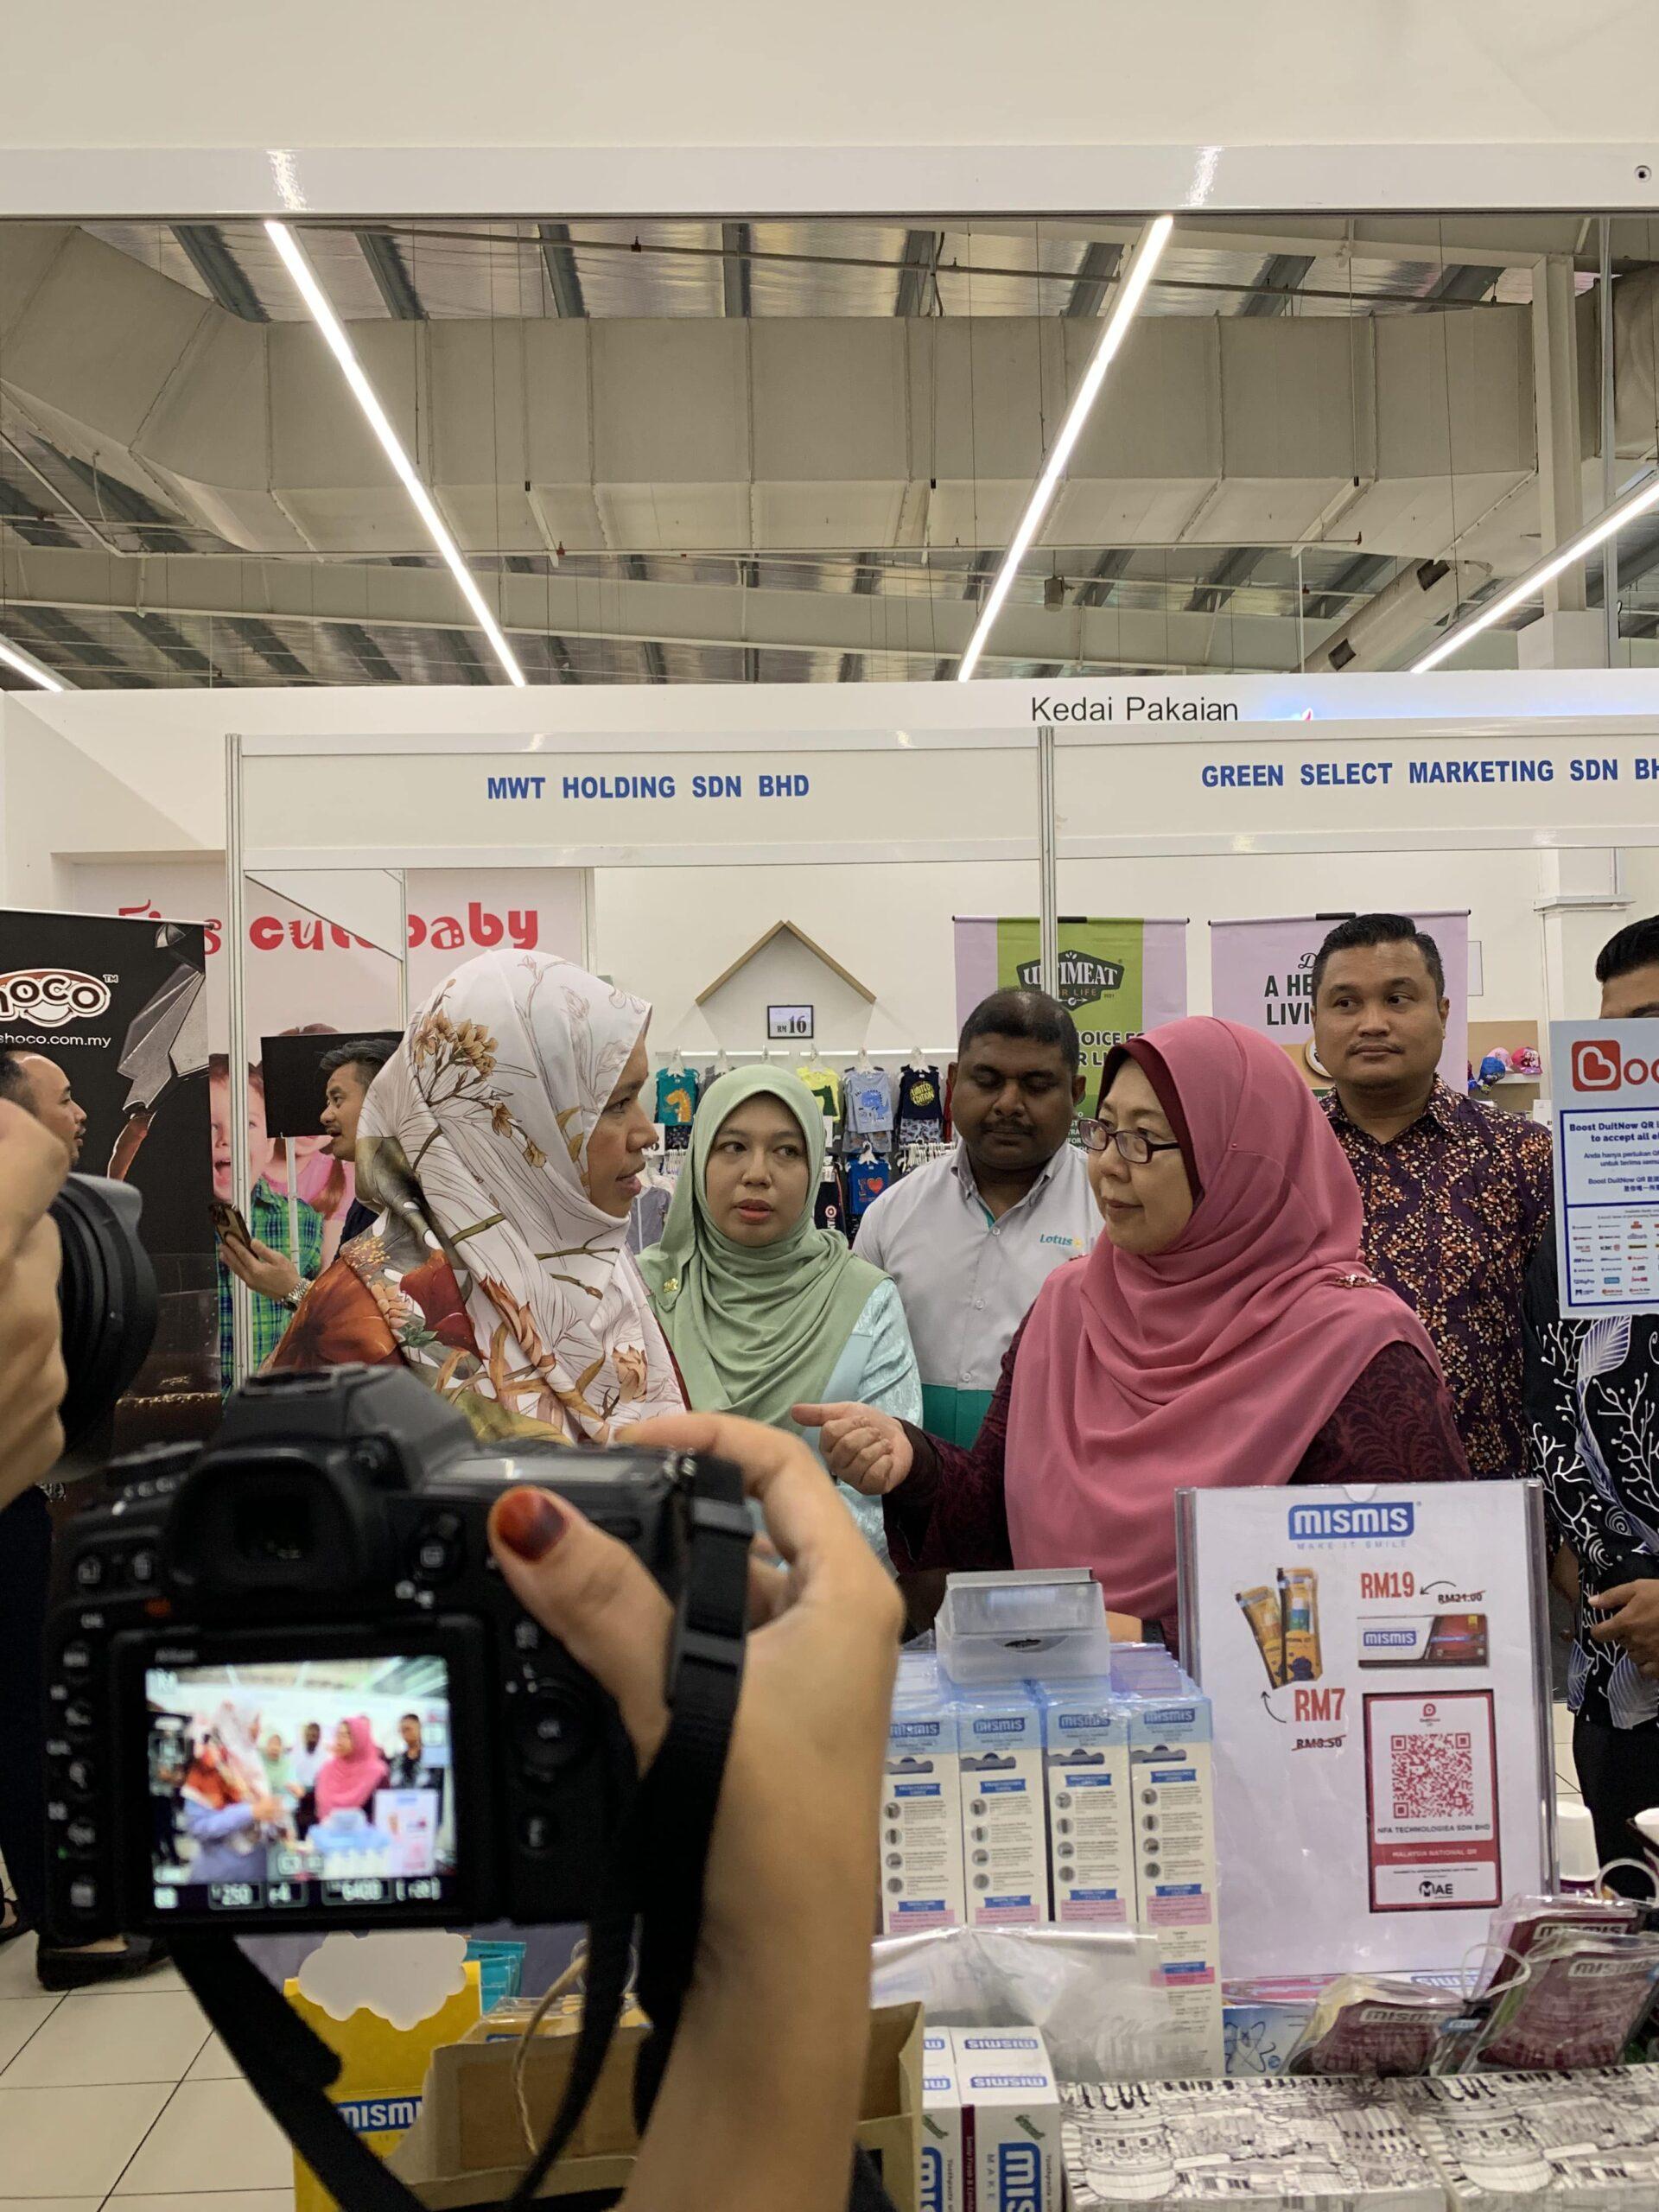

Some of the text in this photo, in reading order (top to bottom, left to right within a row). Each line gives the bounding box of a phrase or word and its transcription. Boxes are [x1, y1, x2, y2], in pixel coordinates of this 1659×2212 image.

[1032, 696, 1238, 721] Kedai Pakaian
[1201, 765, 1284, 787] GREEN
[1300, 762, 1393, 786] SELECT
[1409, 760, 1554, 784] MARKETING
[1569, 759, 1618, 781] SDN
[487, 774, 810, 799] MWT HOLDING SDN BHD
[1264, 975, 1279, 997] A
[788, 1015, 807, 1033] 16
[1267, 1002, 1310, 1026] LIVI
[1569, 1123, 1596, 1132] Boost
[1598, 1122, 1638, 1131] DuitNow
[1603, 1134, 1635, 1143] accept
[1360, 1571, 1415, 1599] RM19
[1294, 1688, 1346, 1722] RM7
